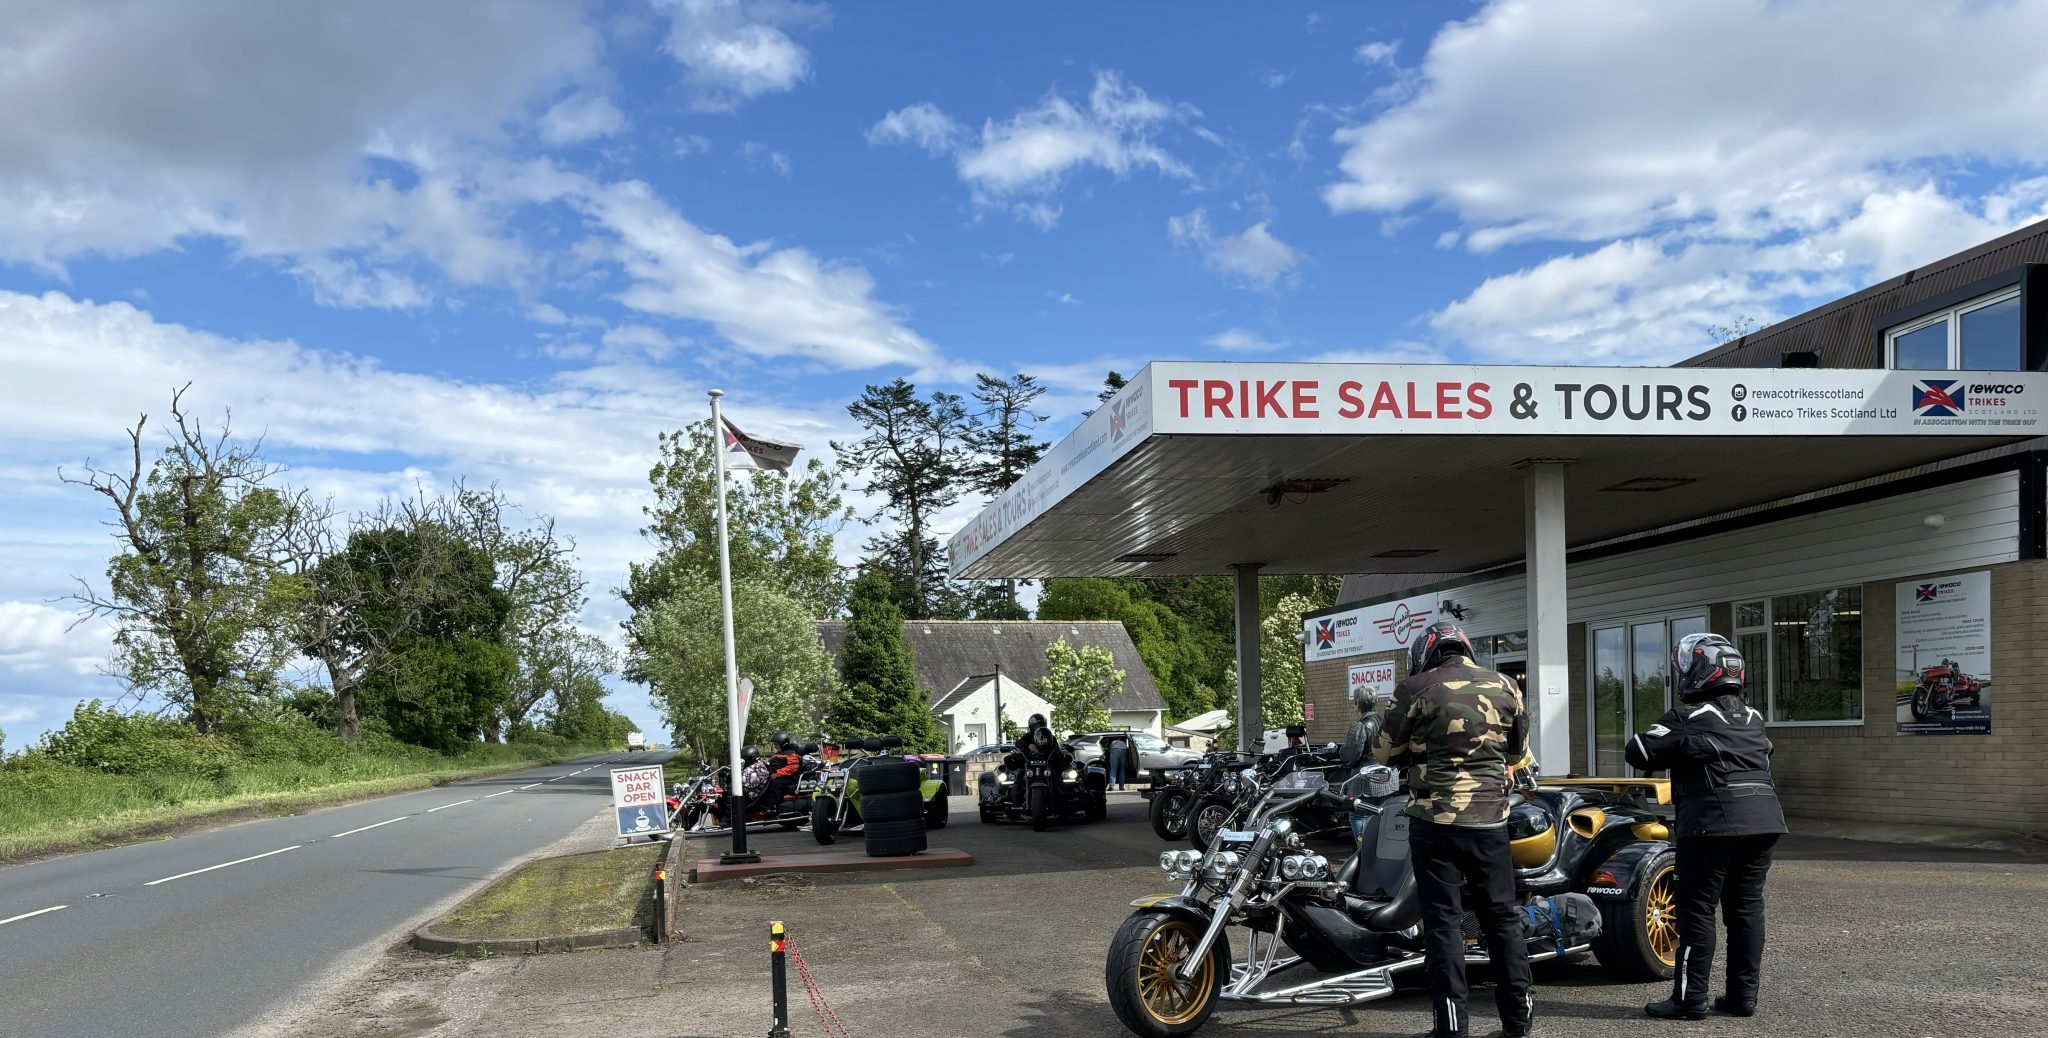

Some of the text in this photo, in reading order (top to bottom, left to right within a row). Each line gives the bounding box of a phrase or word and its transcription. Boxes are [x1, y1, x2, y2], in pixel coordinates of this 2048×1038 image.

[1752, 388, 1864, 399] rewacotrikesscotland
[1968, 383, 2024, 394] rewaco
[1168, 379, 1711, 421] TRIKE SALES & TOURS
[1968, 398, 2006, 406] TRIKES
[1752, 407, 1897, 419] Rewaco Trikes Scotland Ltd
[1913, 418, 1921, 426] IN
[1922, 418, 1967, 426] ASSOCIATION
[1968, 418, 1987, 426] WITH
[1003, 487, 1027, 529] TOURS
[1336, 617, 1357, 628] rewaco
[1336, 629, 1350, 638] TRIKES
[1351, 669, 1392, 685] SNACK BAR
[617, 771, 657, 783] SNACK
[626, 782, 651, 792] BAR
[623, 792, 656, 803] OPEN
[1587, 886, 1623, 895] rewaco
